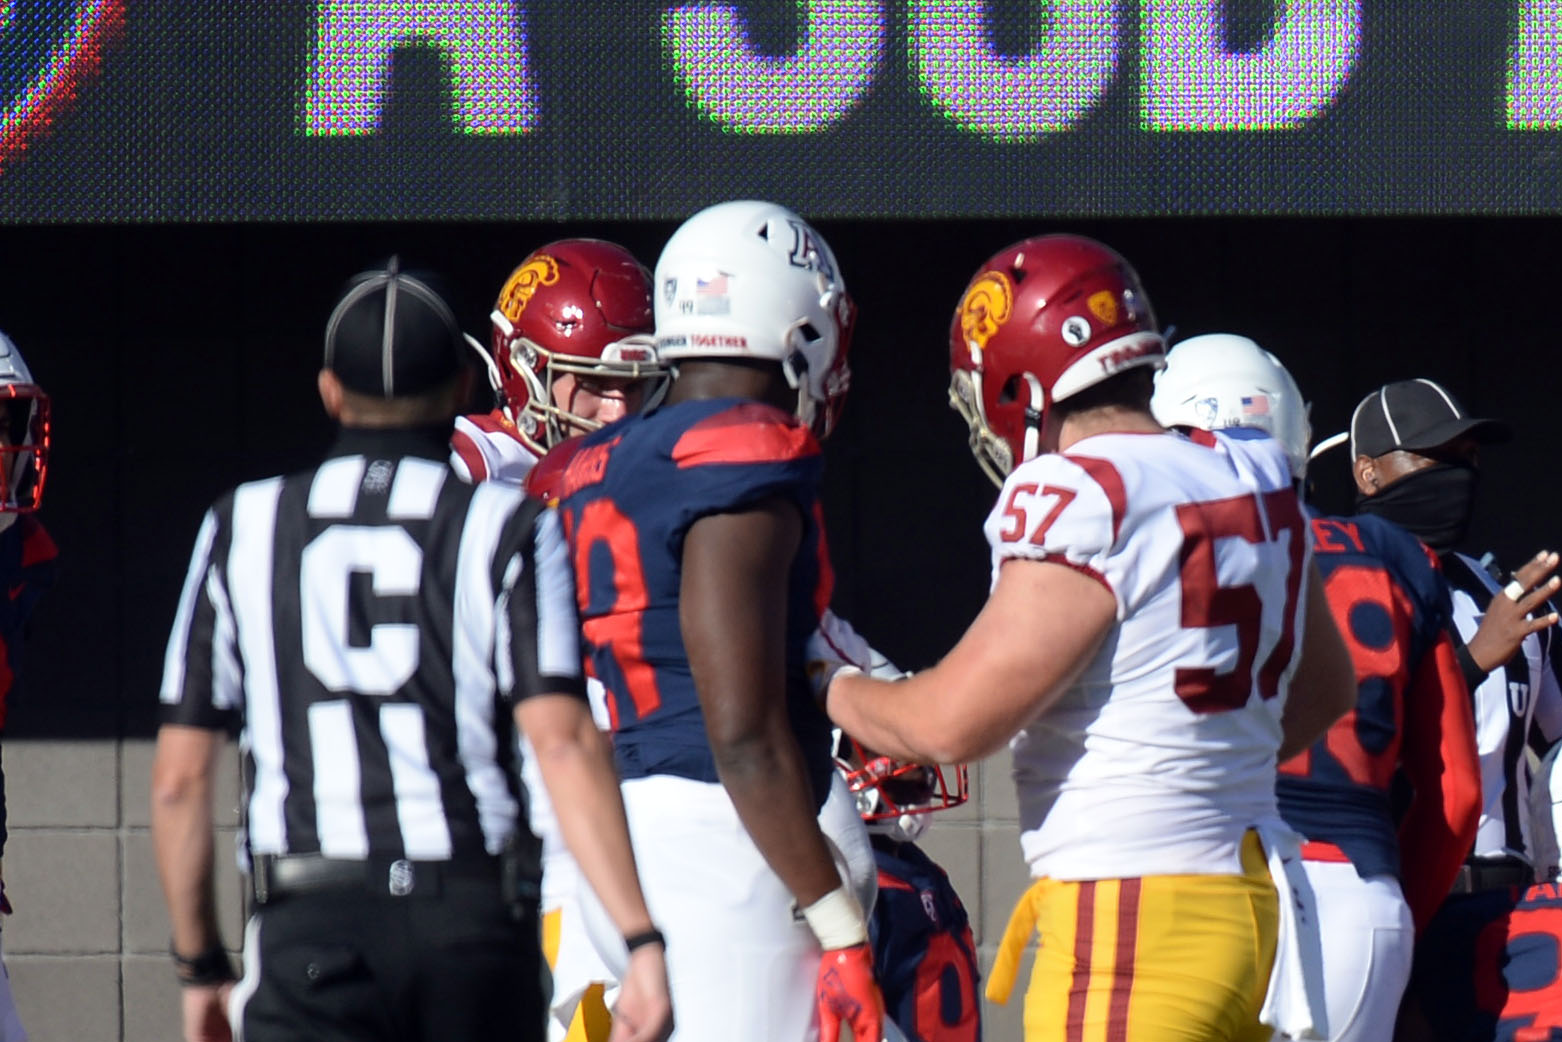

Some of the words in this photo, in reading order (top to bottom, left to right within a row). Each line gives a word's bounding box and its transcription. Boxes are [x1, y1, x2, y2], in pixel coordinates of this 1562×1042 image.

[1000, 482, 1078, 545] 57
[300, 524, 424, 697] C
[1173, 486, 1306, 714] 57
[1507, 681, 1529, 718] U
